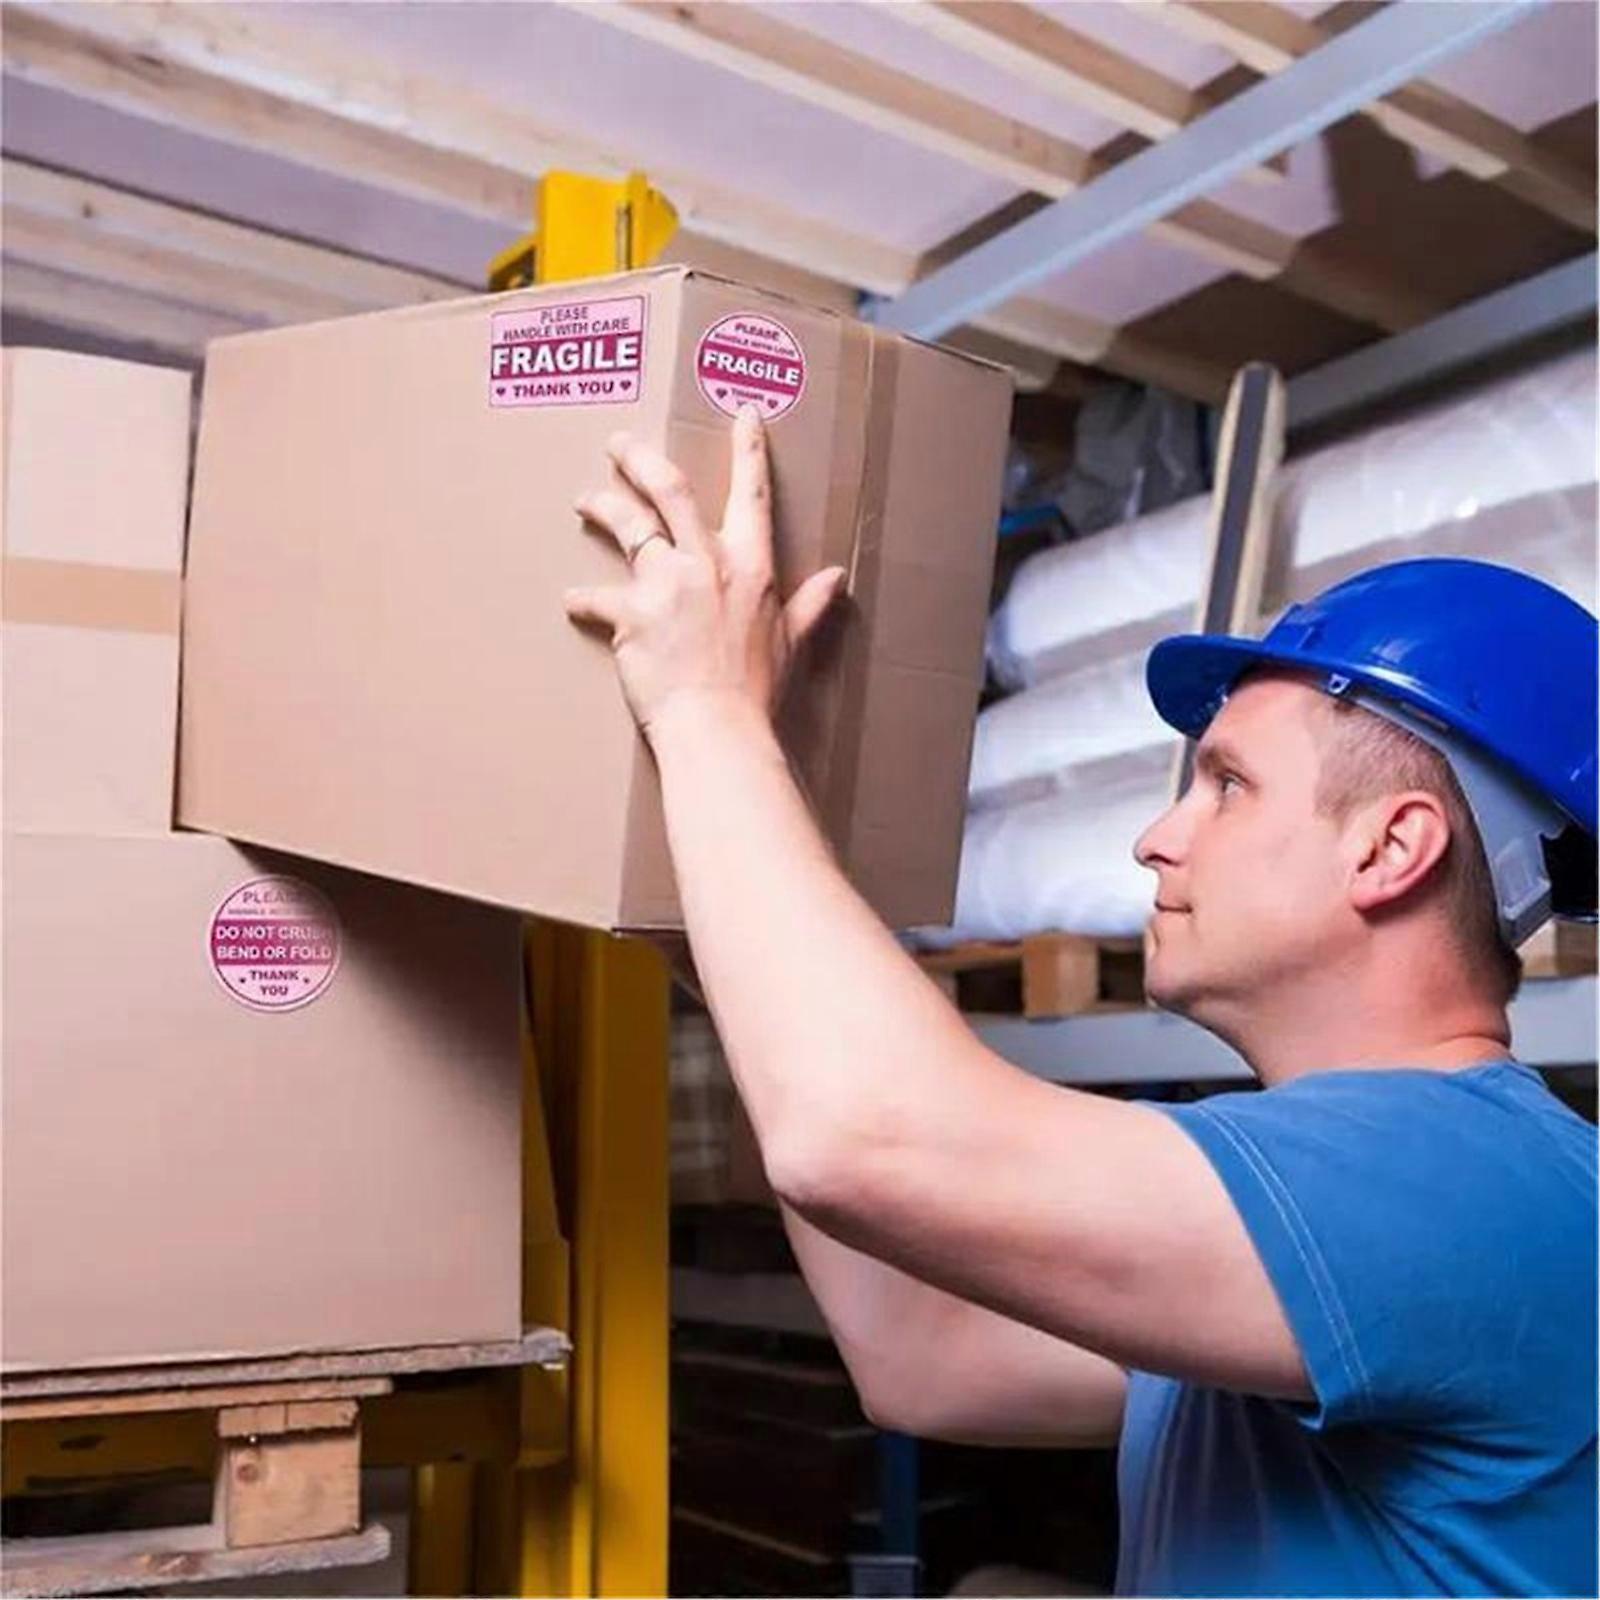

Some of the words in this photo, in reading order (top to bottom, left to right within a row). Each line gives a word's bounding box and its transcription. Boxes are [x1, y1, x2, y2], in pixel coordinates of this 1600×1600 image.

[541, 307, 589, 324] PLEASE
[503, 328, 553, 341] HANDLE
[555, 323, 589, 336] WITH
[592, 317, 630, 333] CARE
[735, 322, 780, 341] PLEASE
[493, 337, 638, 376] FRAGILE
[703, 348, 800, 386] FRAGILE
[513, 383, 570, 398] THANK
[578, 381, 614, 395] YOU
[243, 891, 304, 903] PLEA
[216, 926, 240, 940] DO
[242, 926, 275, 940] NOT
[216, 946, 260, 960] BEND
[263, 946, 287, 960] OR
[290, 946, 332, 960] FOLD
[250, 970, 299, 981] THANK
[260, 985, 289, 996] YOU
